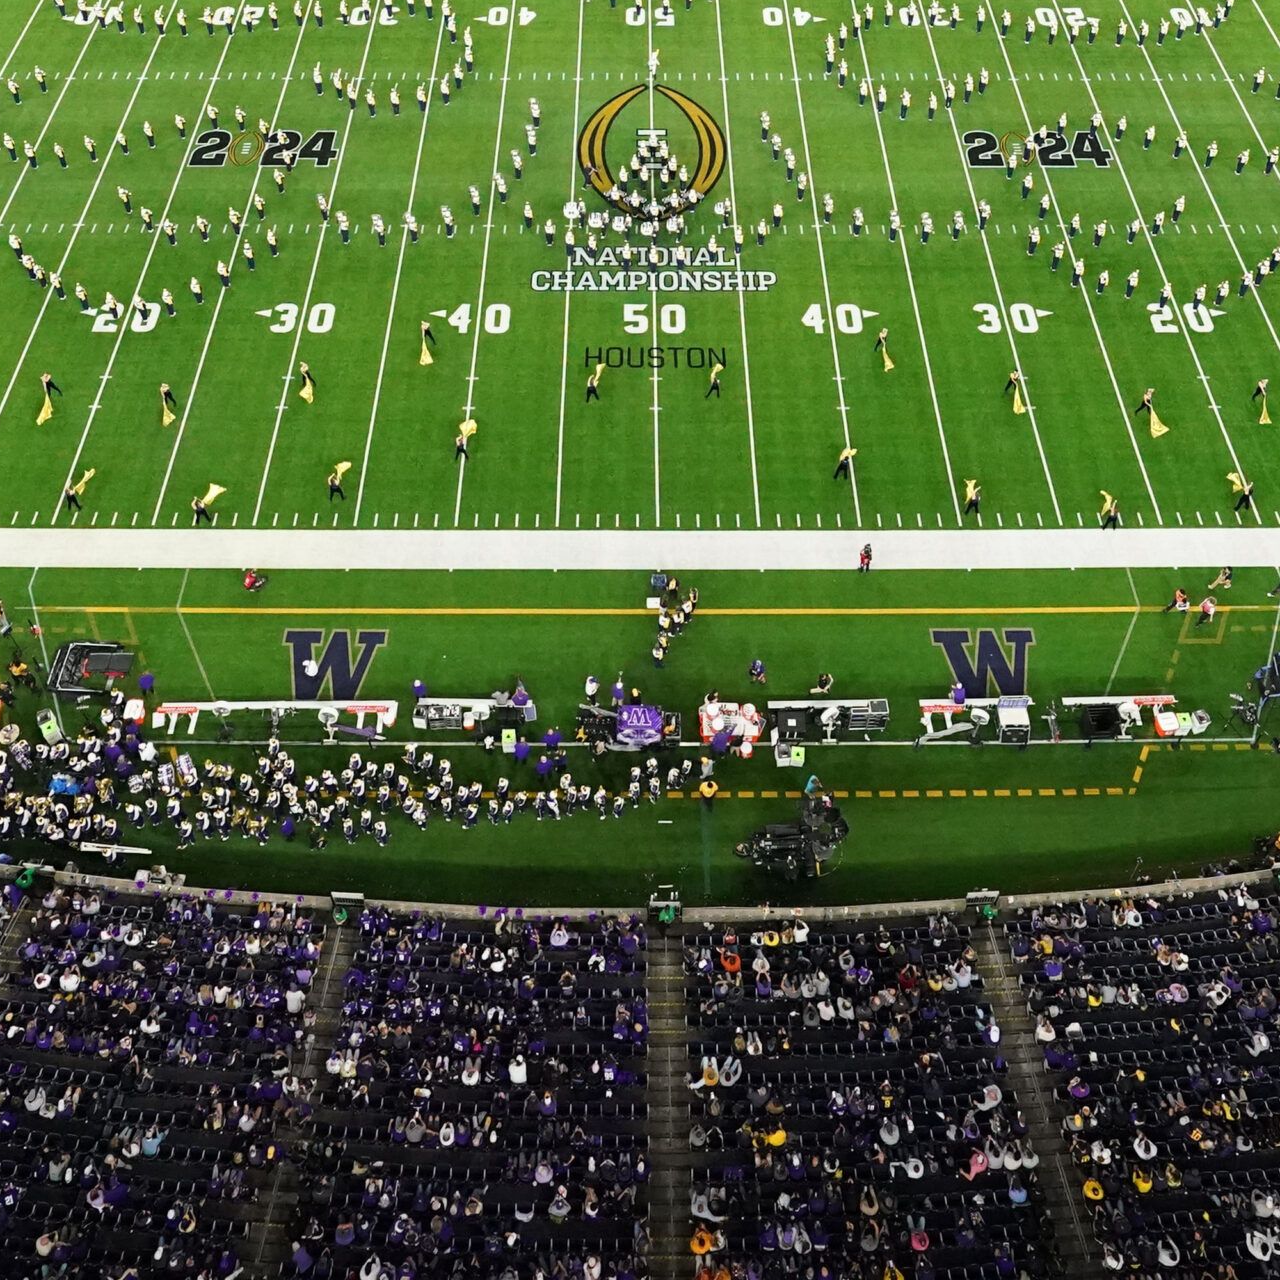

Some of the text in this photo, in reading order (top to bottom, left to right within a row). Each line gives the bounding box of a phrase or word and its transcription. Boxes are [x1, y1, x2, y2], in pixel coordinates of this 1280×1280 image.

[487, 6, 537, 26] 40
[626, 6, 675, 26] 50
[762, 6, 812, 26] 40
[571, 246, 736, 267] NATIONAL
[530, 270, 778, 292] CHAMPIONSHIP
[90, 303, 161, 333] 20
[269, 303, 336, 333] 30
[447, 303, 511, 333] 40
[623, 303, 687, 335] 50
[801, 303, 863, 334] 40
[972, 303, 1039, 334] 30
[1149, 303, 1215, 334] 20
[585, 346, 727, 369] HOUSTON
[282, 627, 389, 700] W
[929, 626, 1035, 698] W
